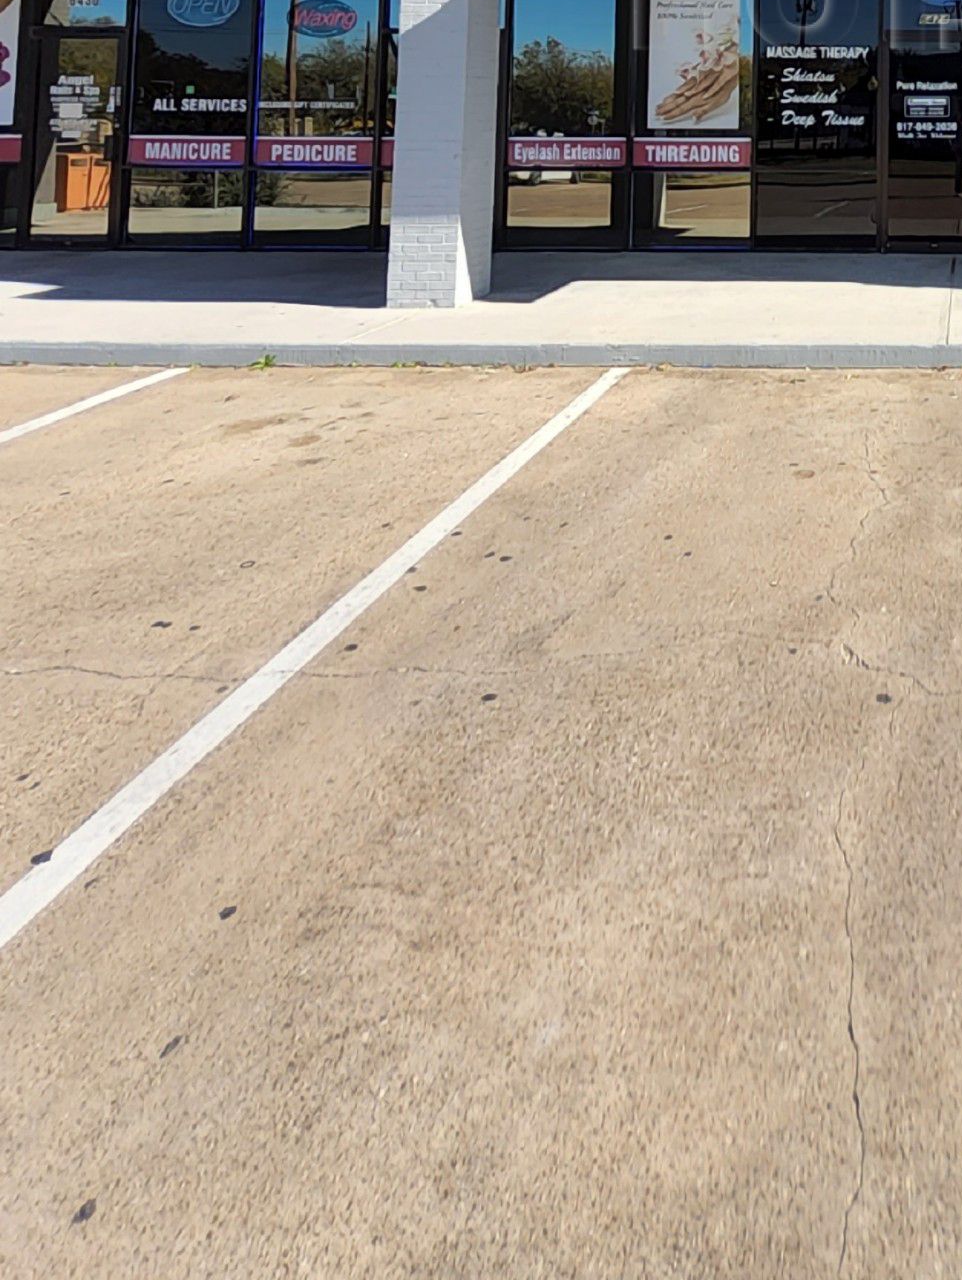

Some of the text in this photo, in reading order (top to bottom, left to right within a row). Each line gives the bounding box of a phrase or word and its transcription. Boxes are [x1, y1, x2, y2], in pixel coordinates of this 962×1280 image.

[293, 6, 358, 28] Waxing
[766, 46, 869, 59] MASSAGE THERAPY
[780, 67, 836, 82] Shiatsu
[153, 98, 248, 112] ALL SERVICES
[780, 88, 839, 104] Swedish
[781, 109, 866, 128] Deep Tissue
[145, 142, 232, 160] MANICURE
[270, 144, 358, 162] PEDICURE
[513, 143, 621, 162] Eyelash Extension
[645, 144, 741, 162] THREADING
